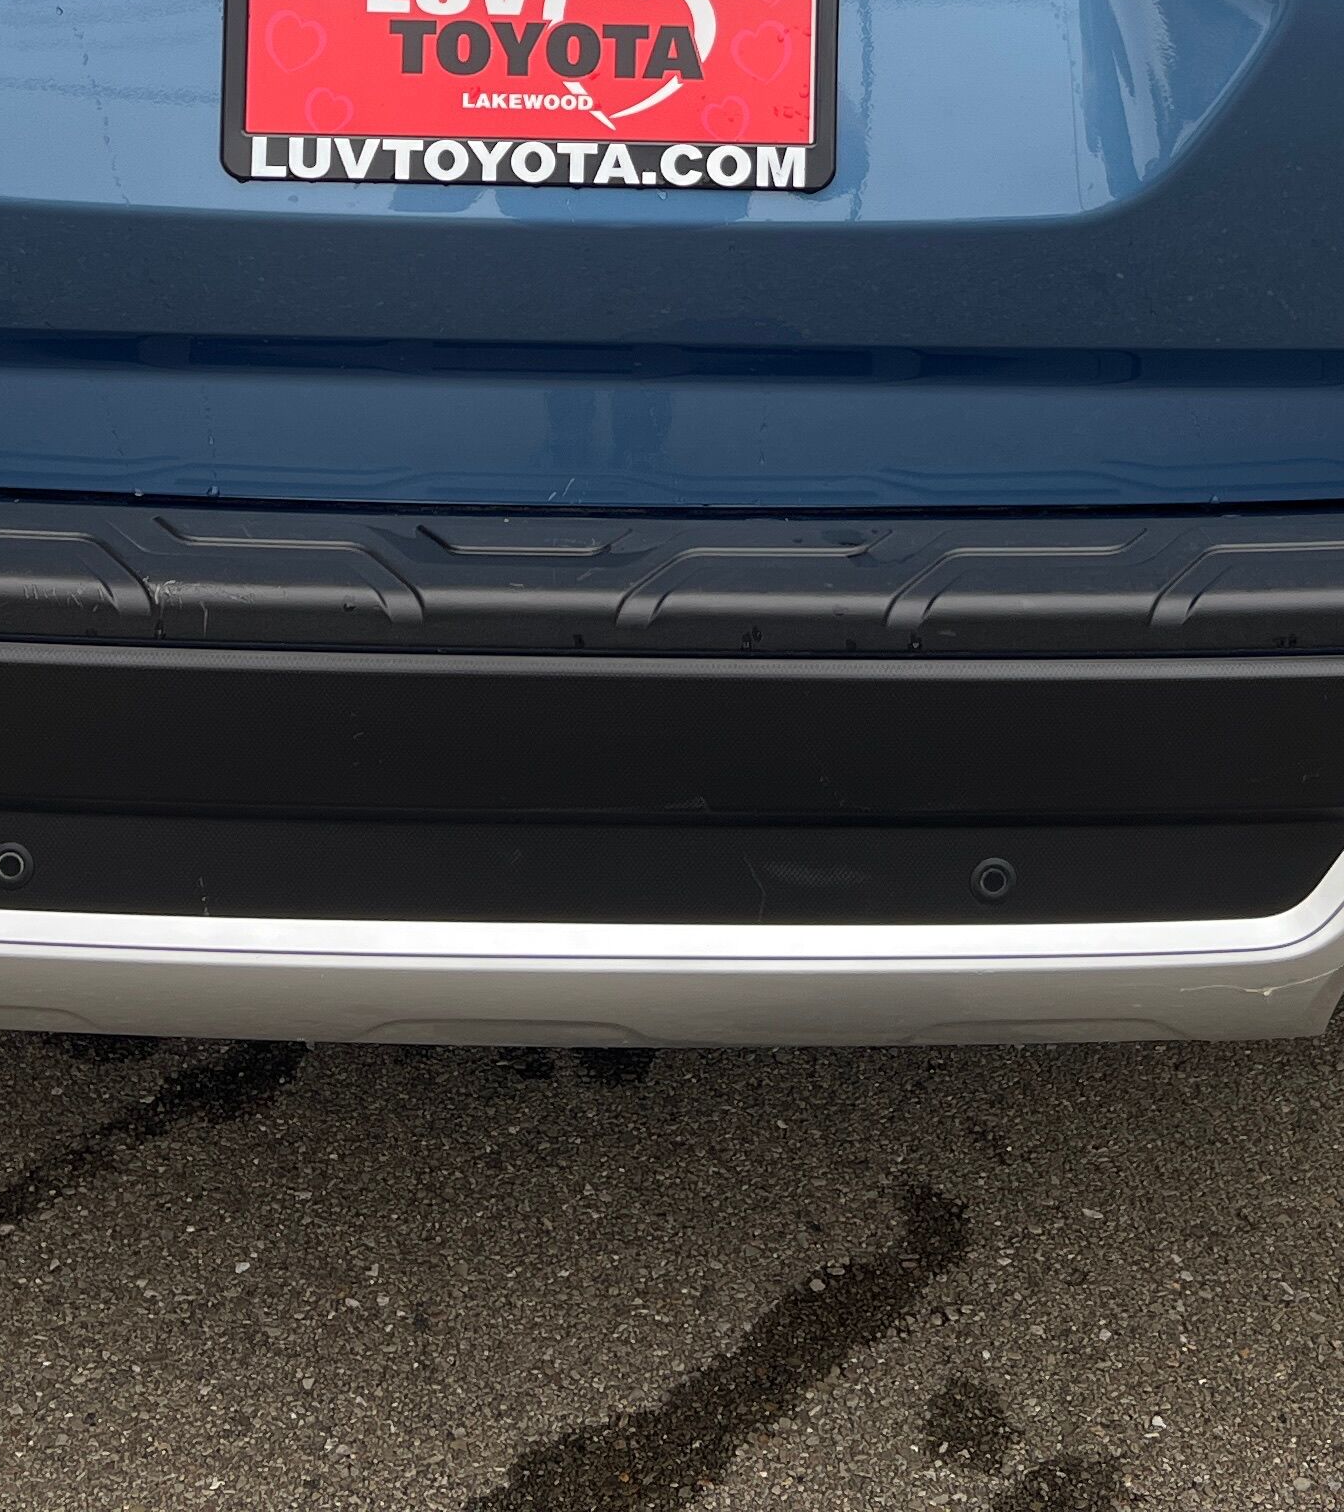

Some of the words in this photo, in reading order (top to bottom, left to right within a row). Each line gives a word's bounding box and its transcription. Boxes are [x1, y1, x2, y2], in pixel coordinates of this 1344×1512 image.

[388, 19, 704, 80] TOYOTA
[462, 91, 594, 112] LAKEWOOD
[250, 135, 807, 188] LUVTOYOTA.COM
